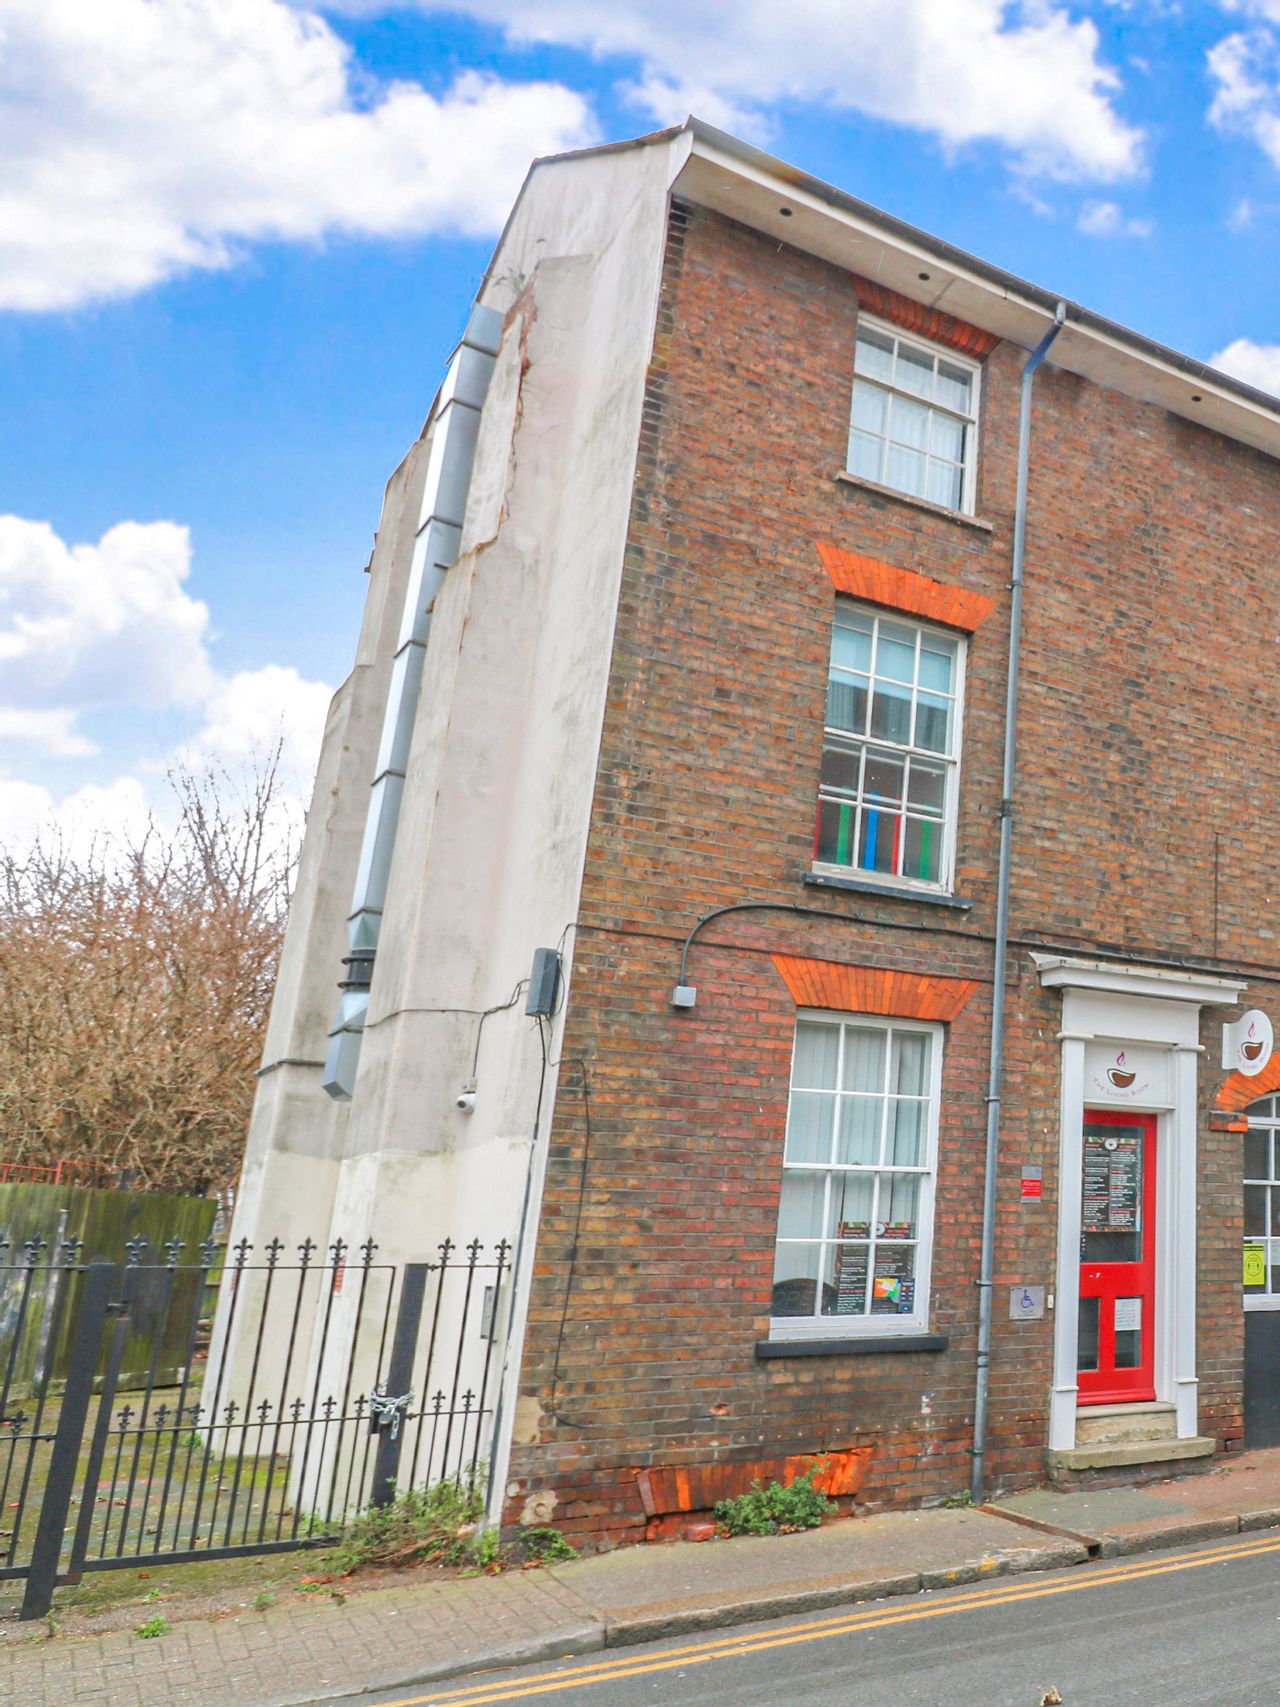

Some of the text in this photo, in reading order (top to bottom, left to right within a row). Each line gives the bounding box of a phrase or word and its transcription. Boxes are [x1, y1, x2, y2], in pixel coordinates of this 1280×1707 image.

[1093, 1077, 1149, 1098] THE LIVING ROOM
